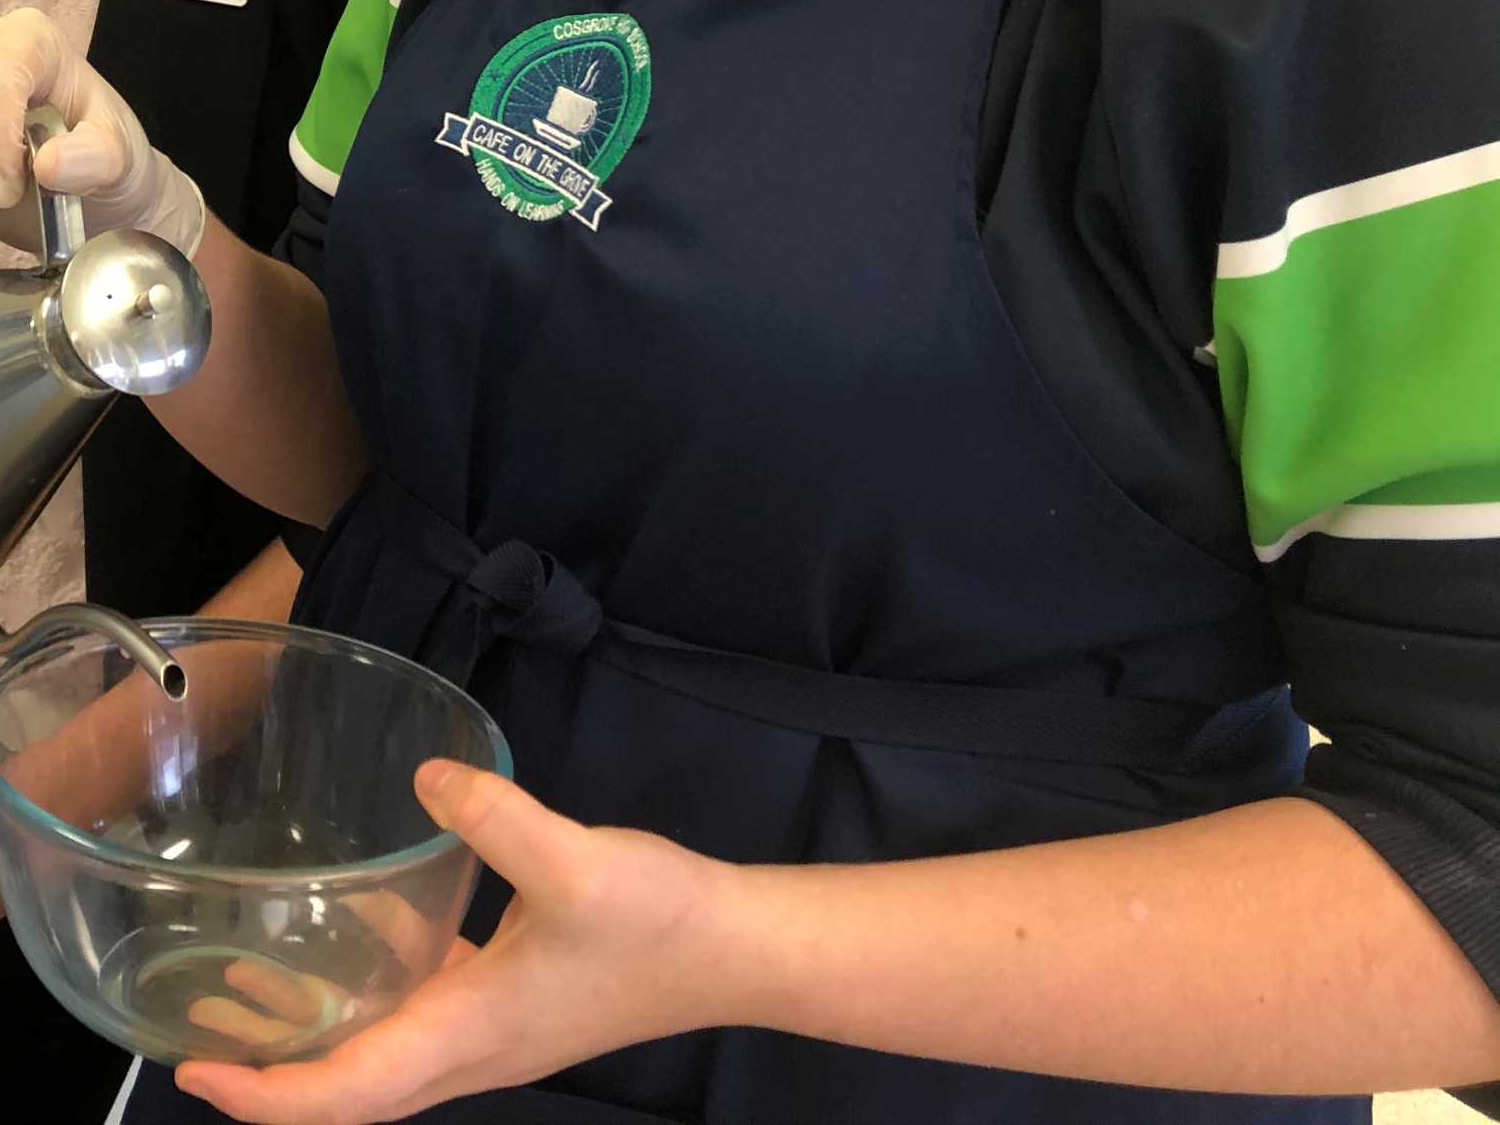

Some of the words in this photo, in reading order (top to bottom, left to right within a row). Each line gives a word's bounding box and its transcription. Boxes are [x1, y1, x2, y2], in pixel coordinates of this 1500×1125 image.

[472, 124, 513, 154] CAFE
[513, 142, 537, 166] ON
[536, 153, 563, 179] THE
